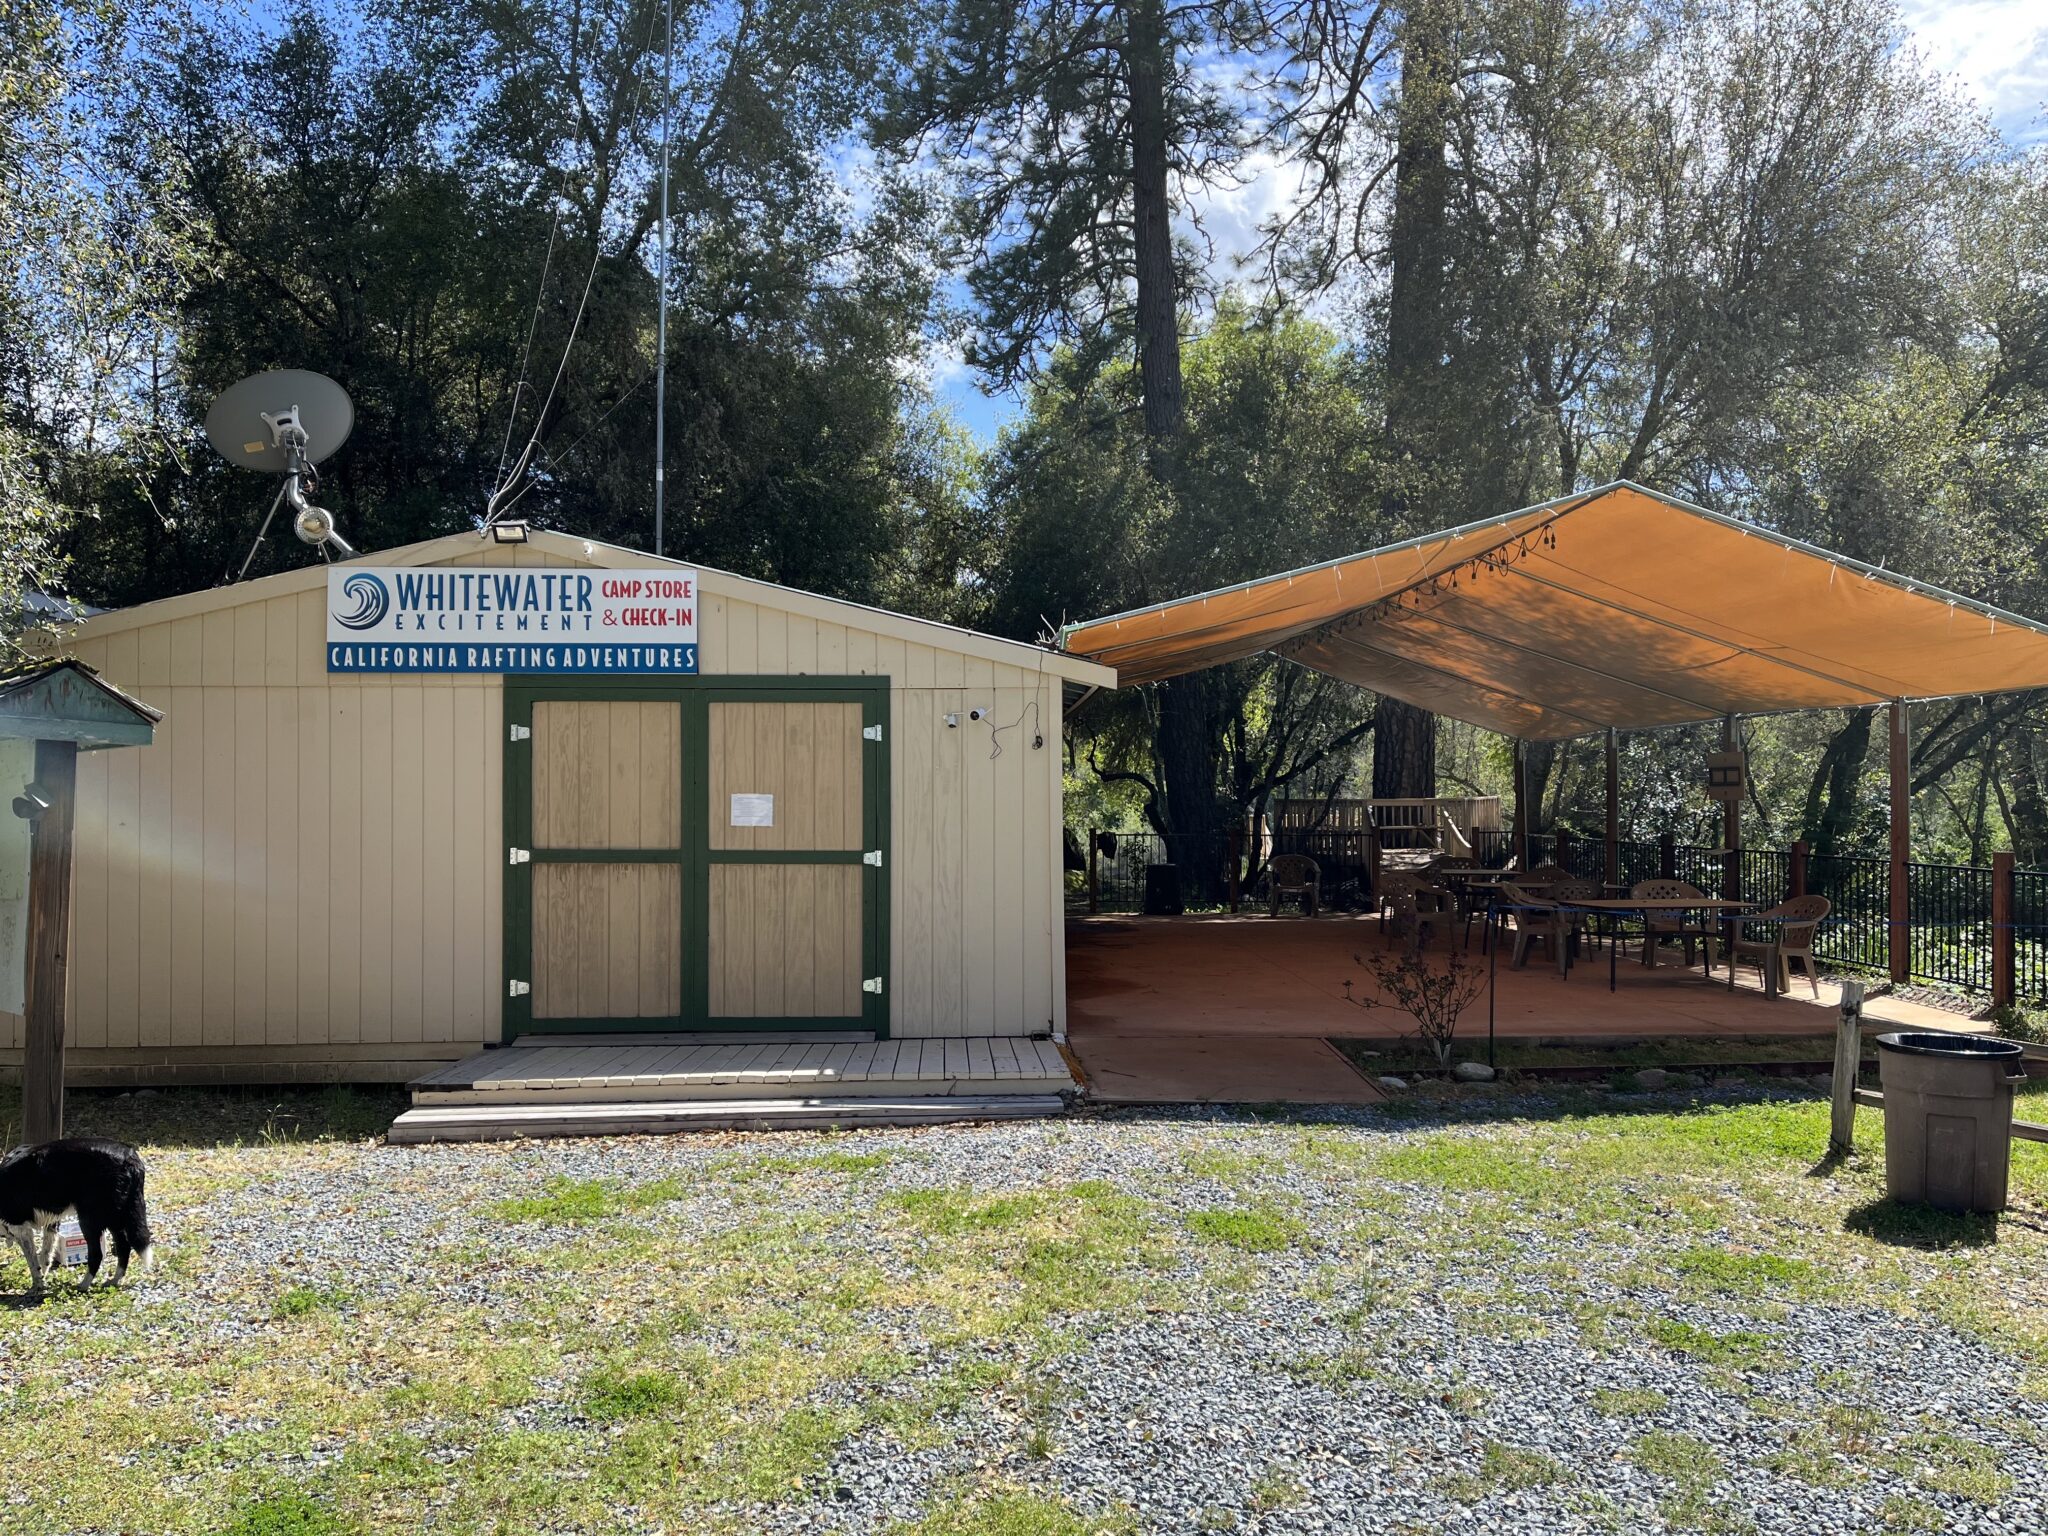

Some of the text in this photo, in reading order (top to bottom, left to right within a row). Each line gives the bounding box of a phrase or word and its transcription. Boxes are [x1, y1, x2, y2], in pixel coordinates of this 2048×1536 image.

[395, 573, 593, 612] WHITEWATER
[601, 580, 692, 599] CAMP STORE
[395, 613, 592, 631] EXCITEMENT
[602, 608, 692, 627] & CHECK-IN
[331, 647, 694, 668] CALIFORNIA RAFTING ADVENTURES
